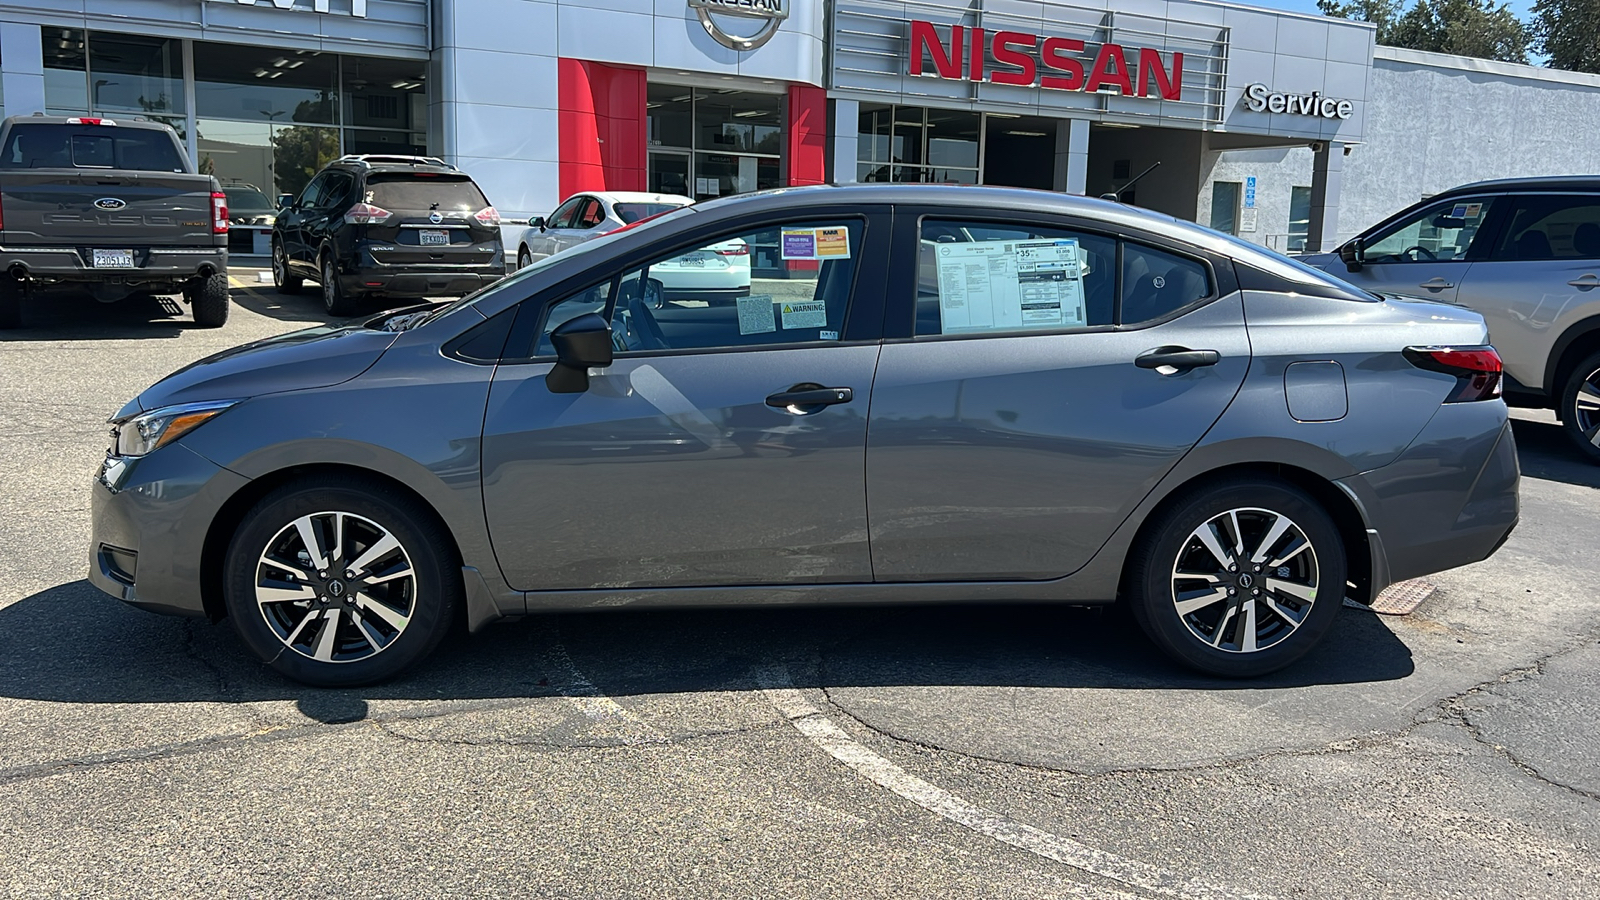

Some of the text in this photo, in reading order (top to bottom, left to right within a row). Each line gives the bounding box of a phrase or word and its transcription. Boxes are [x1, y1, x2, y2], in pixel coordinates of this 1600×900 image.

[909, 20, 1184, 100] NISSAN
[1246, 83, 1354, 120] Service
[42, 214, 178, 227] F-150
[1020, 249, 1030, 257] 35
[792, 304, 825, 313] WARNING:
